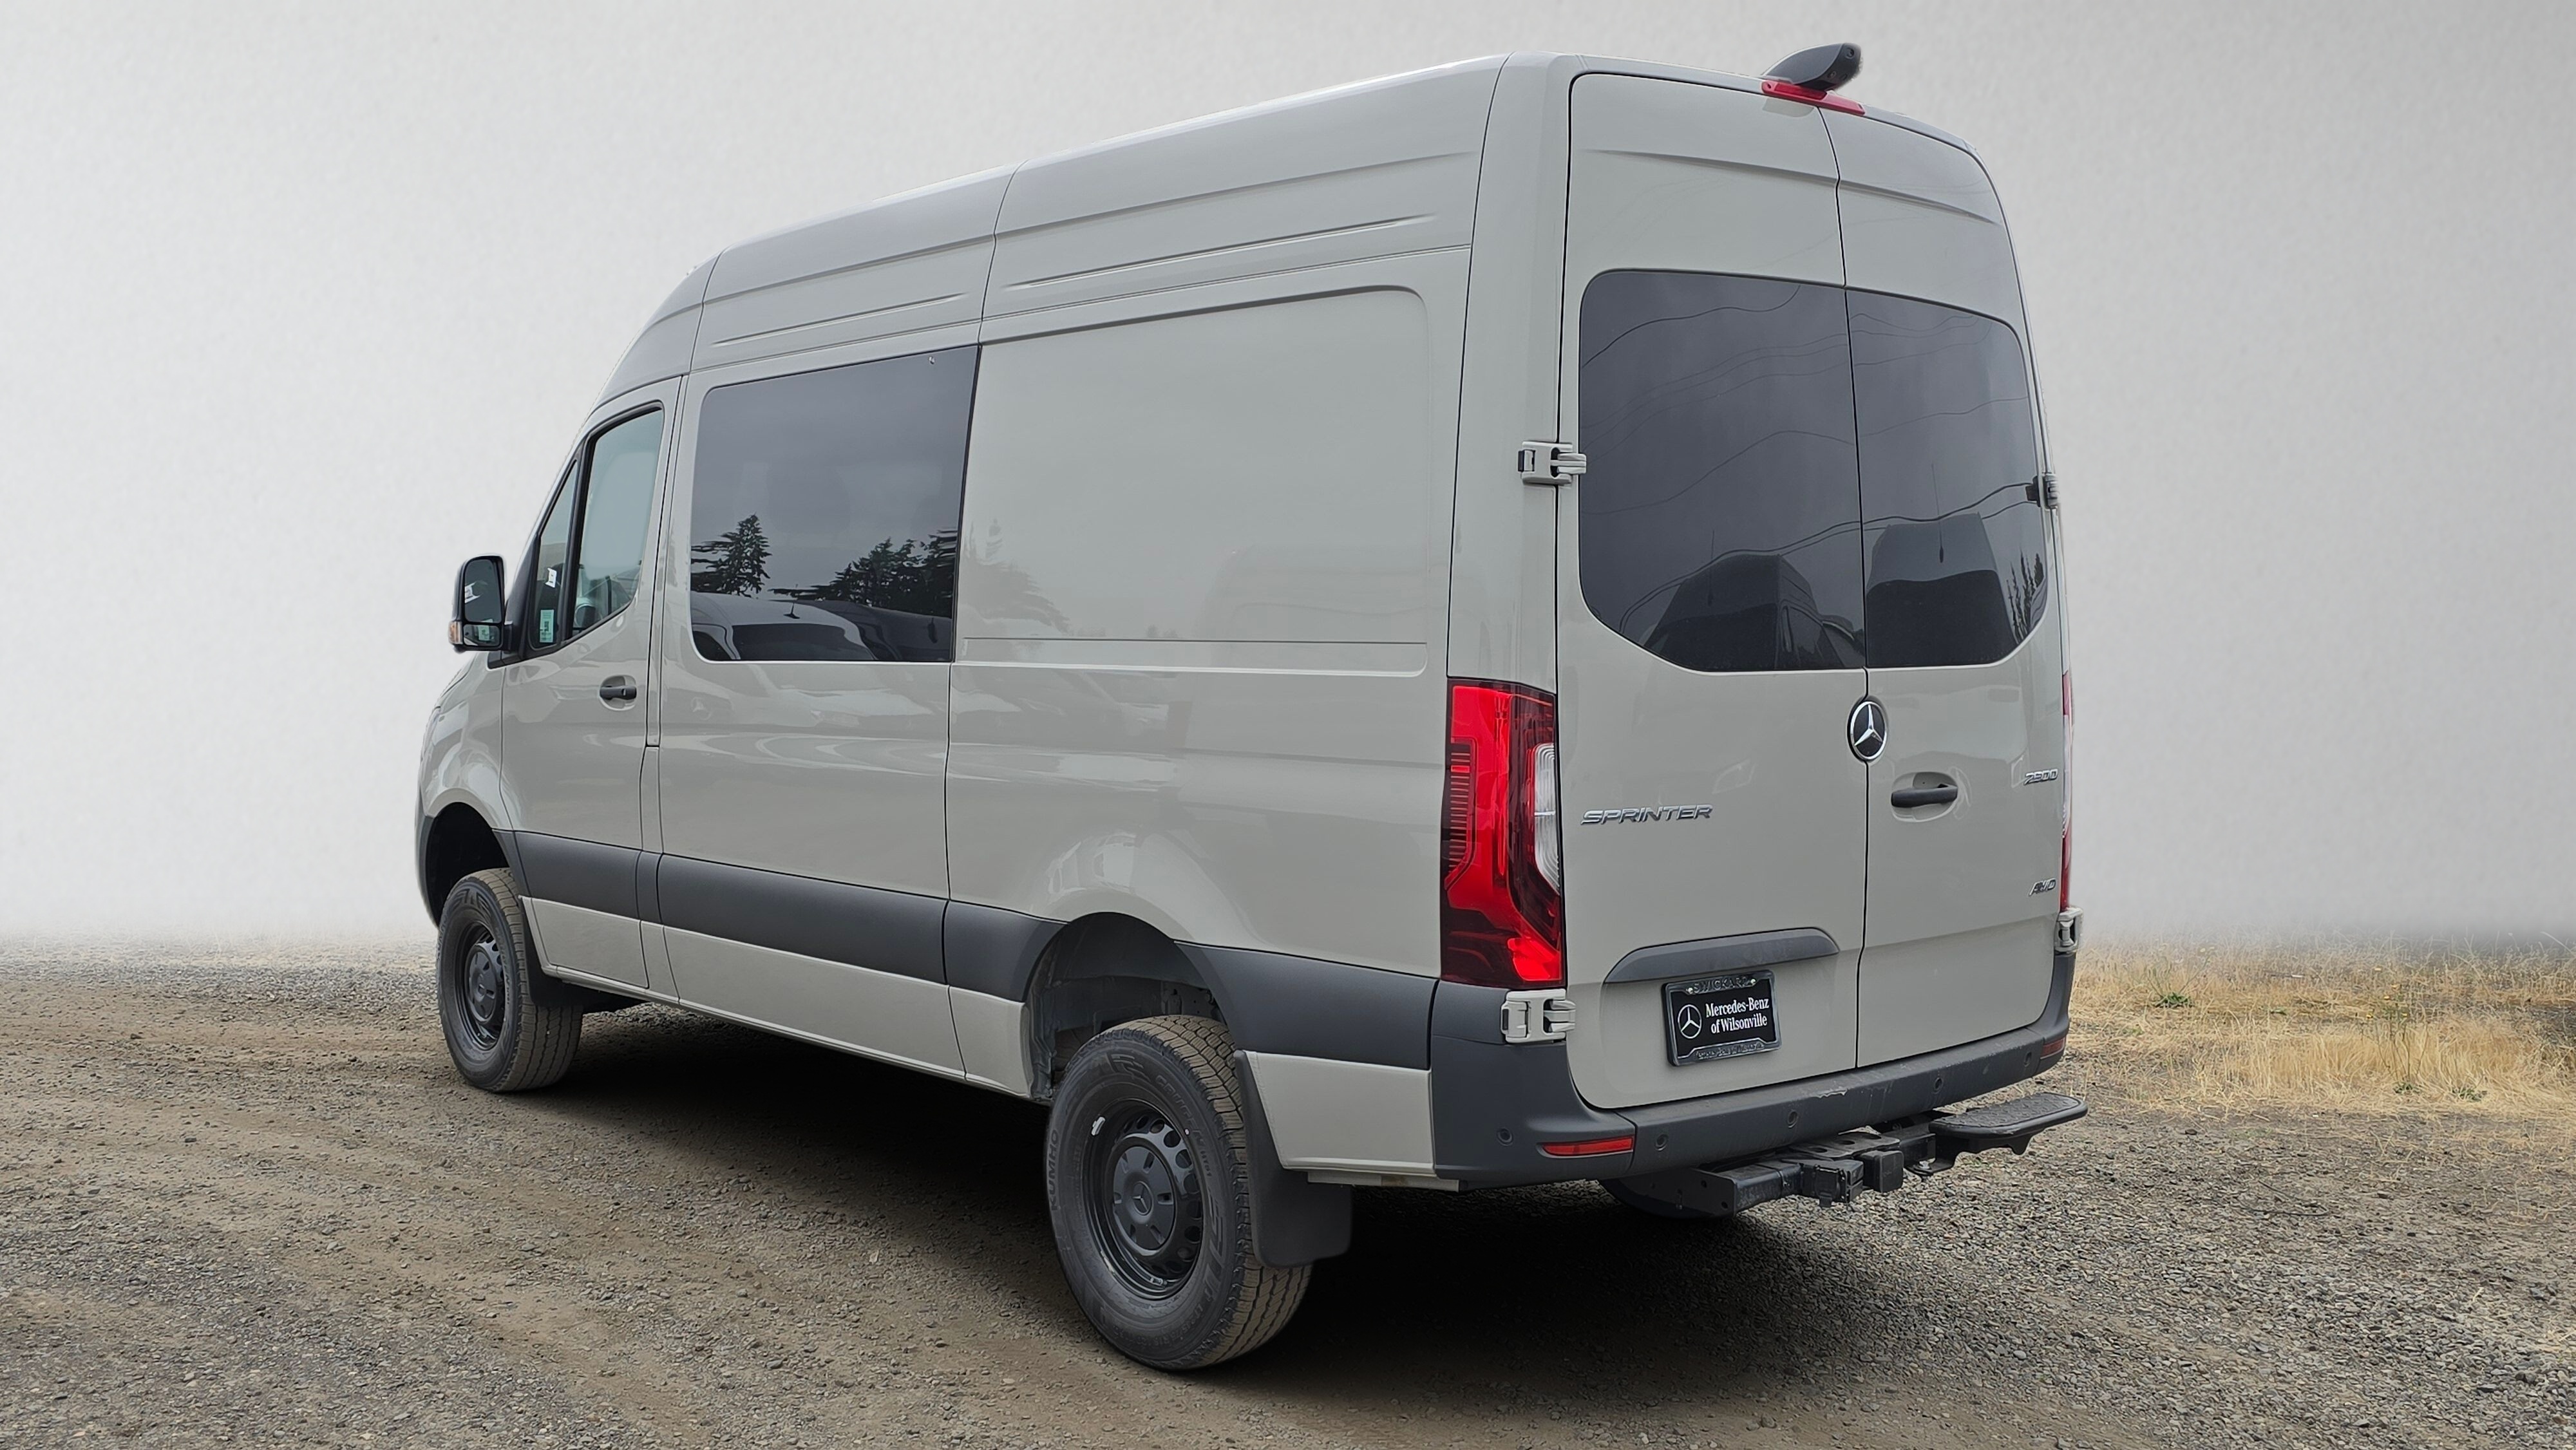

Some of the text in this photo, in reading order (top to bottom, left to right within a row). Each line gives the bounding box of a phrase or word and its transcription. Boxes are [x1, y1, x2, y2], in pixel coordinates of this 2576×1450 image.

[2023, 769, 2058, 786] 2500
[1580, 804, 1713, 825] SPRINTER
[2029, 878, 2056, 896] AWD
[1705, 997, 1769, 1018] Mercedes-Benz
[1710, 1013, 1768, 1034] of Wilsonville
[1049, 1129, 1058, 1211] KUMHO
